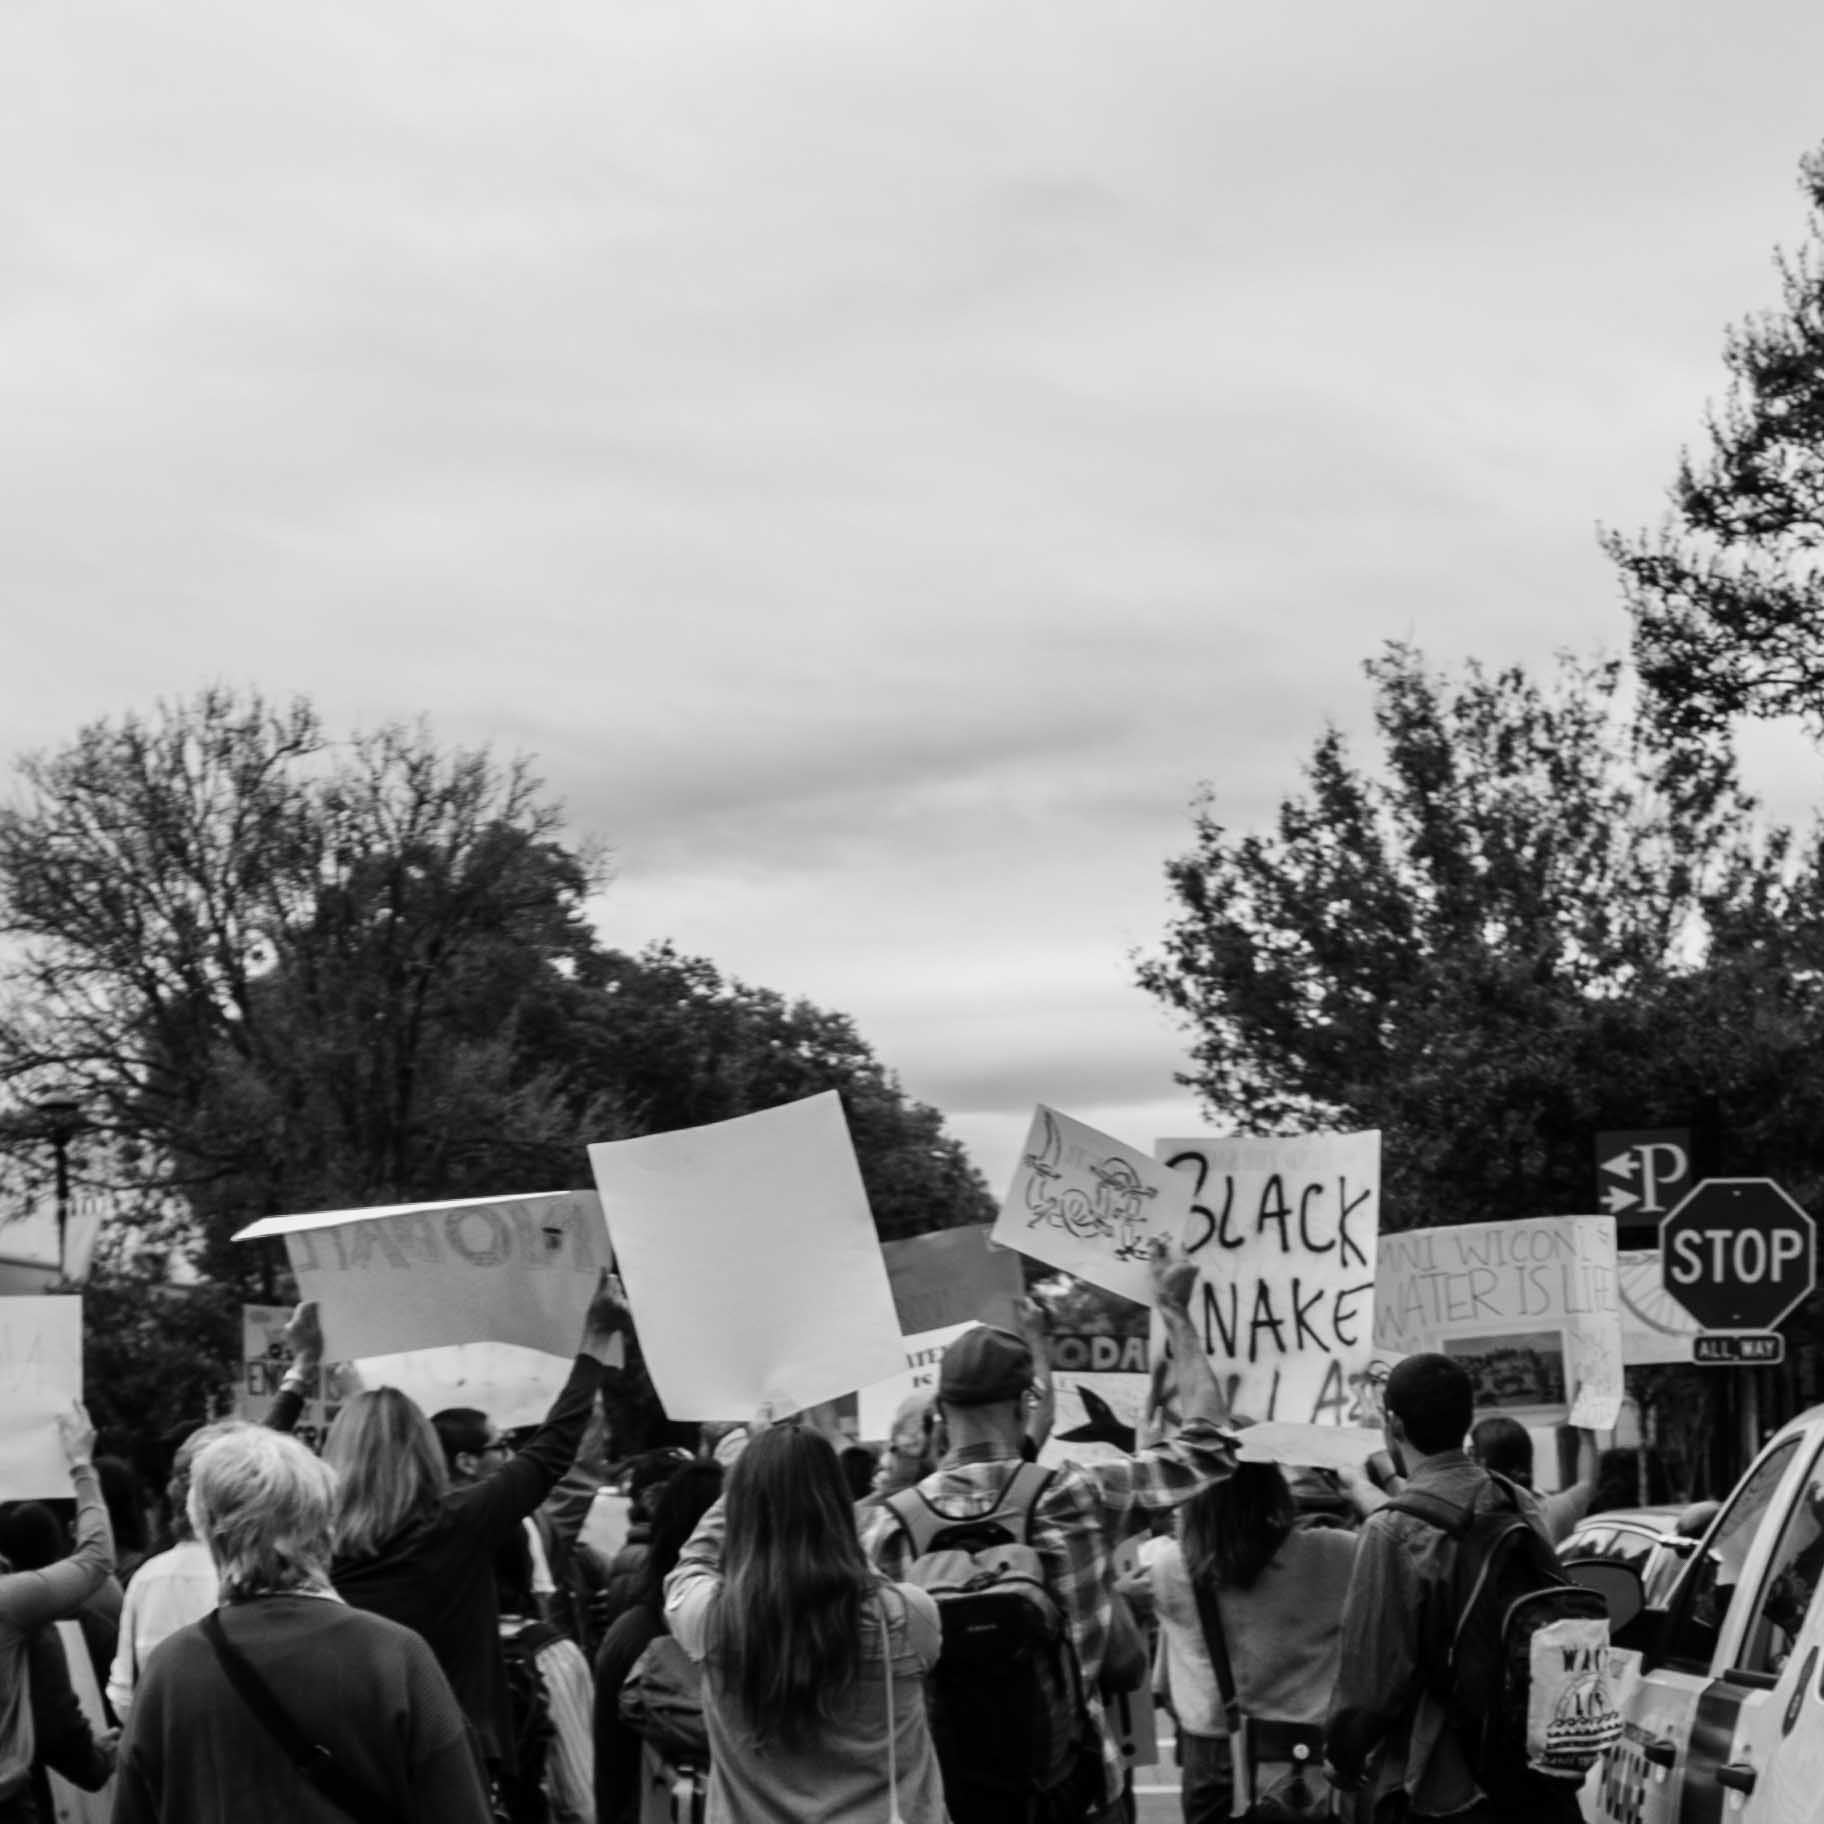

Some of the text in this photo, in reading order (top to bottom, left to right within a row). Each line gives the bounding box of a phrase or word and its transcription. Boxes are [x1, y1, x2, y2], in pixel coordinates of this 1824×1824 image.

[1632, 1143, 1688, 1213] P
[1671, 1228, 1804, 1284] STOP
[1202, 1278, 1375, 1362] NAKE
[1374, 1267, 1505, 1339] WATER
[1515, 1264, 1552, 1317] IS
[1699, 1340, 1775, 1357] ALL WAY
